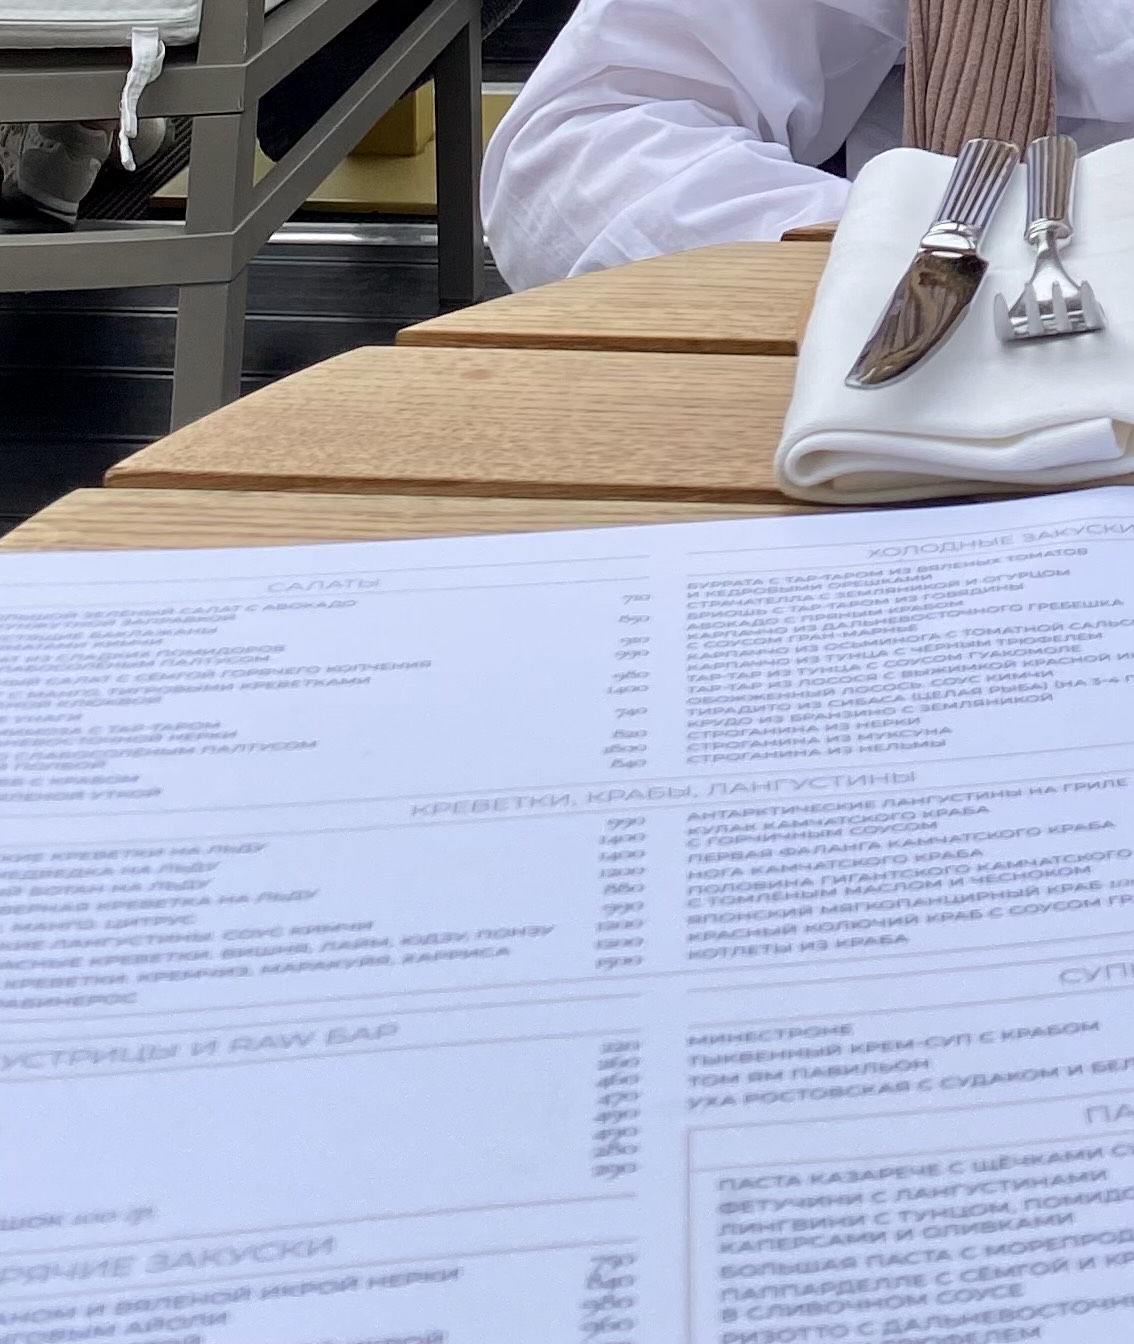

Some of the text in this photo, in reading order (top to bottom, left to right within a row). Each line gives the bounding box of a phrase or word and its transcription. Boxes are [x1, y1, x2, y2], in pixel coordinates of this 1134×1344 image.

[867, 534, 1013, 557] ХОЛОДНЫЕ
[266, 578, 380, 592] САЛАТЫ
[410, 770, 917, 816] КРЕВЕТКИ, КРАБЫ, ЛАНГУСТИНЫ
[1027, 784, 1058, 796] НА
[1061, 777, 1128, 793] ГРИЛЕ
[189, 1039, 220, 1057] И
[227, 1031, 316, 1054] RAW
[322, 1023, 400, 1045] БАР
[892, 1227, 915, 1241] И
[147, 1237, 335, 1271] ЗАКУСКИ
[863, 1248, 953, 1268] ПАСТА
[1074, 1254, 1098, 1270] И
